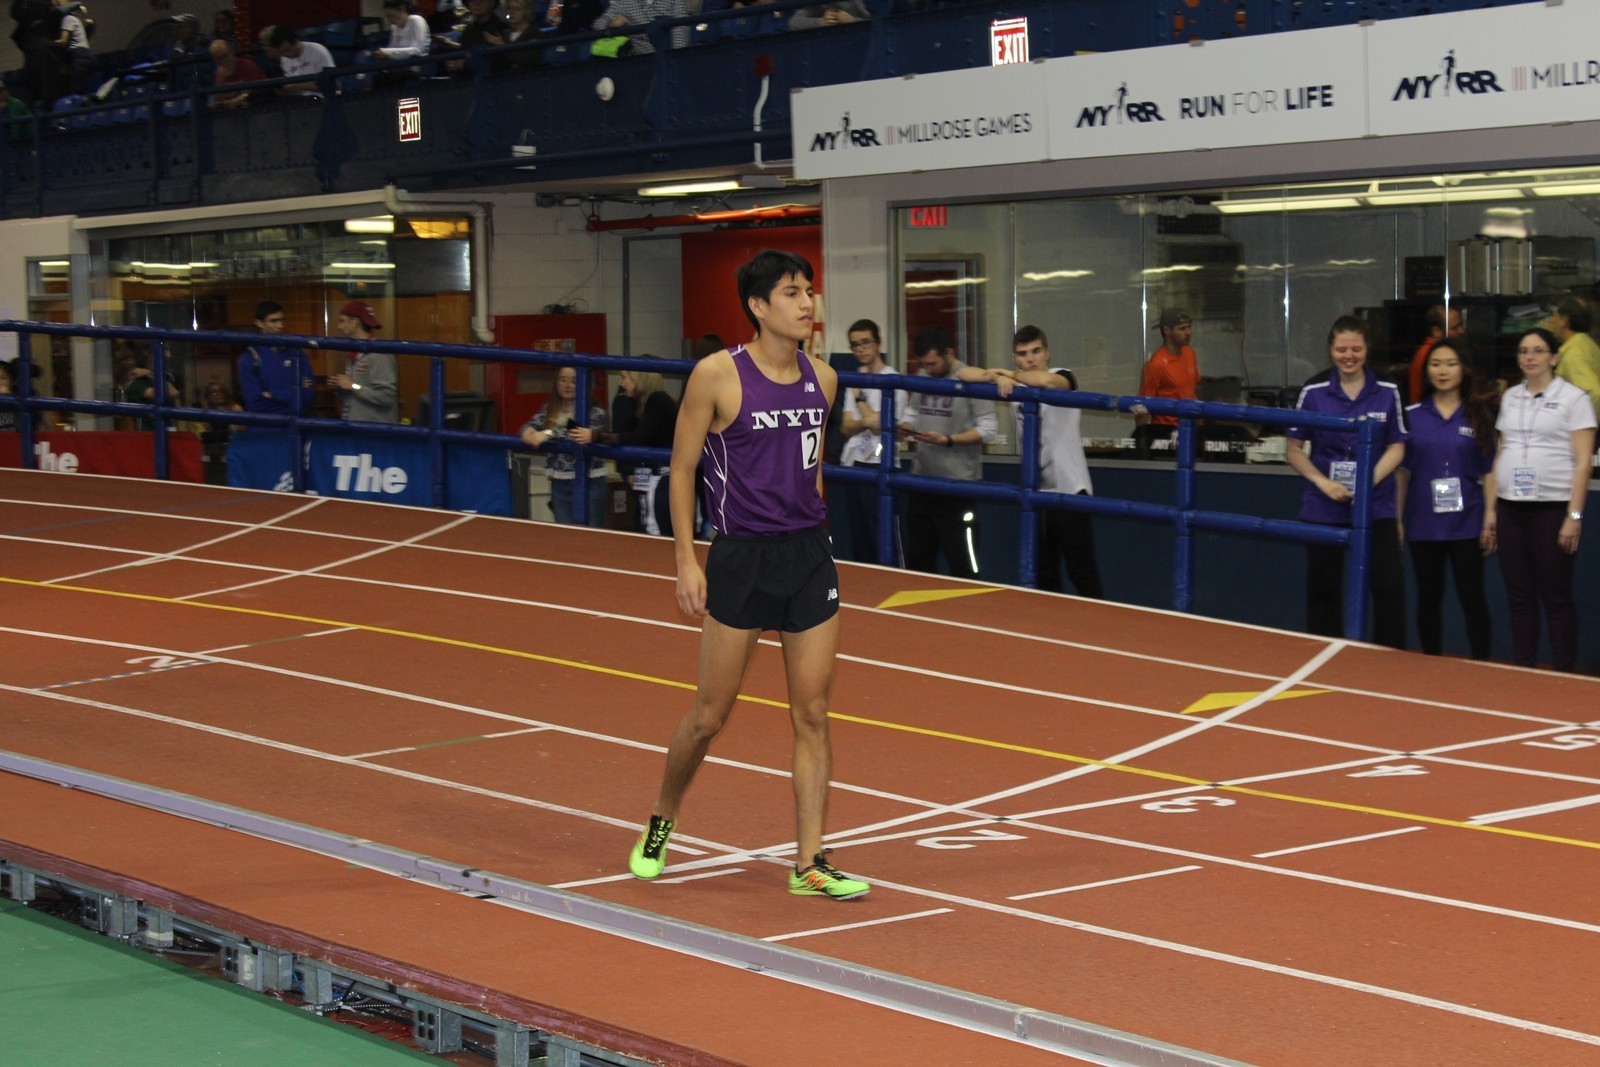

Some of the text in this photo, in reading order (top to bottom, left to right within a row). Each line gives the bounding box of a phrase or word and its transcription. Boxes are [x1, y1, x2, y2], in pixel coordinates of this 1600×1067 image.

[995, 32, 1026, 65] EXIT
[1180, 95, 1225, 120] RUN
[1233, 90, 1279, 114] FOR
[1285, 84, 1334, 110] LIFE
[400, 111, 418, 135] EXIT
[898, 118, 972, 144] MILLROSE
[974, 112, 1033, 137] GAMES
[751, 408, 824, 430] NYU
[807, 432, 818, 466] 2
[1114, 438, 1136, 449] LIFE
[1205, 441, 1229, 452] RUN
[35, 441, 79, 473] he
[332, 453, 408, 494] The
[1521, 734, 1600, 751] 5
[1345, 764, 1431, 778] 4
[1141, 795, 1236, 813] 3
[915, 829, 1029, 850] 2
